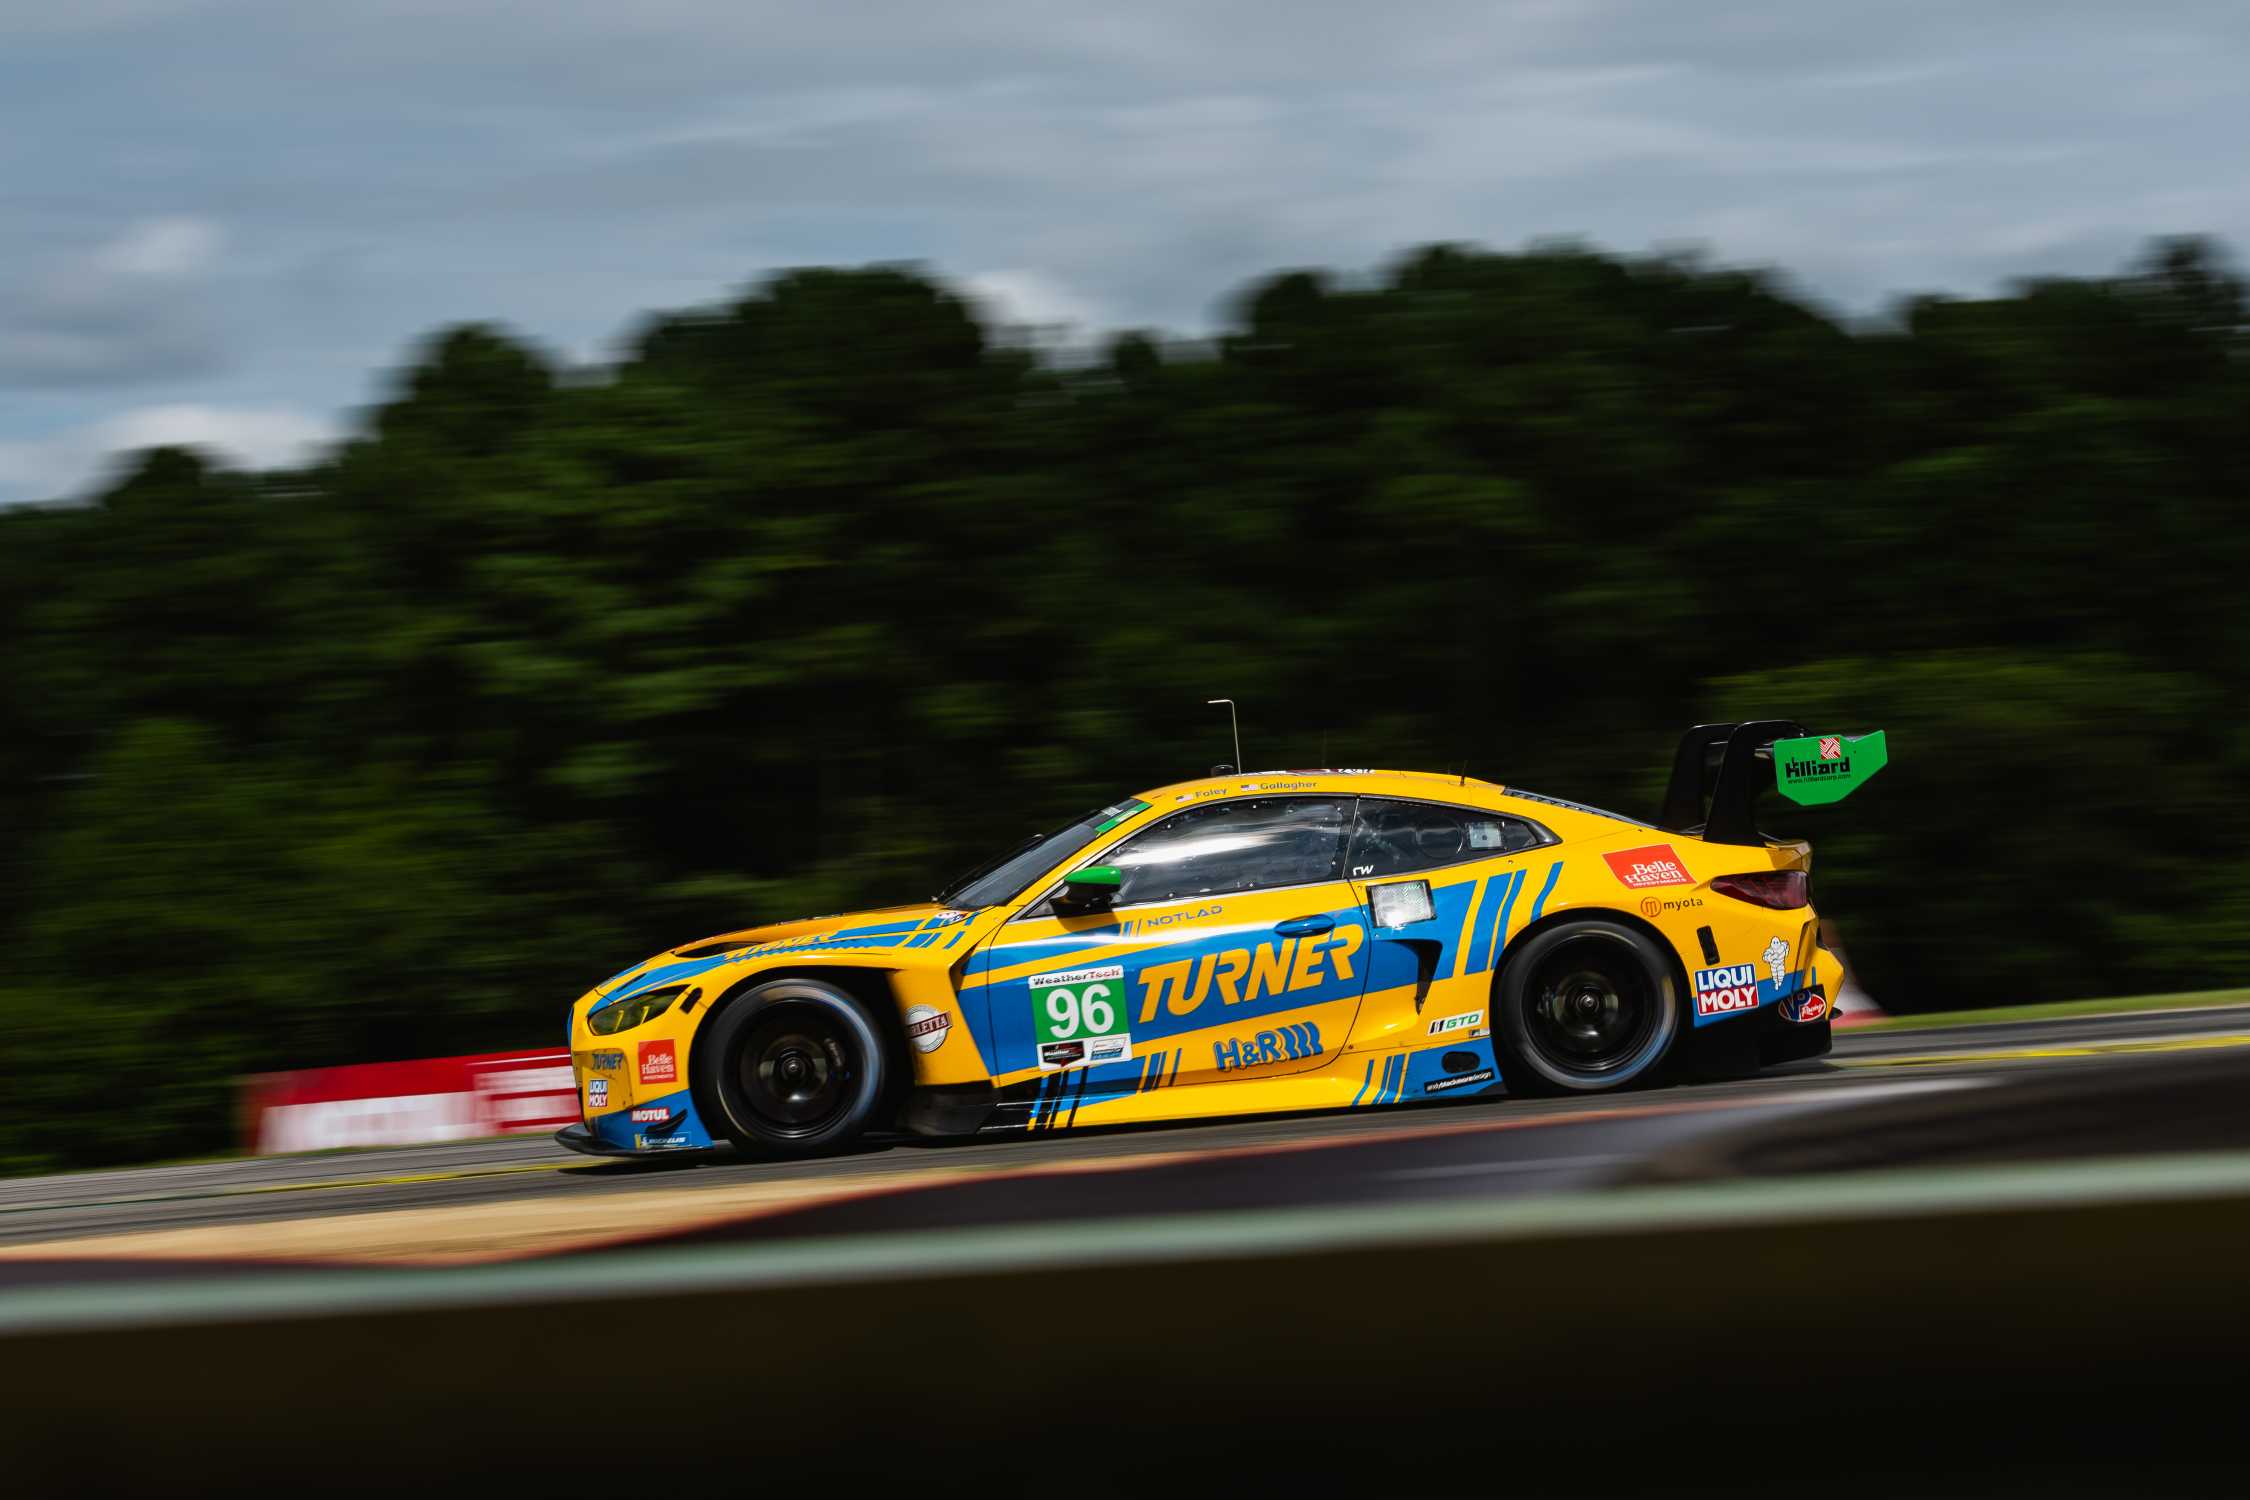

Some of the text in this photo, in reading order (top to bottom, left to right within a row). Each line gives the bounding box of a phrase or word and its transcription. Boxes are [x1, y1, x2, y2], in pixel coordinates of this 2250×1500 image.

[1785, 757, 1851, 779] Hilliard
[1195, 787, 1228, 798] Foley
[1260, 780, 1318, 791] Gallagher
[1632, 860, 1678, 876] Belle
[1624, 870, 1683, 884] Haven
[1663, 897, 1704, 912] myota
[1147, 904, 1223, 928] NOTLAD
[1032, 967, 1121, 987] WeatherTech
[1138, 924, 1364, 1025] TURNER
[1697, 965, 1754, 991] LIQUI
[1699, 986, 1757, 1014] MOLY
[1046, 983, 1115, 1039] 96
[1446, 1013, 1480, 1030] GTD
[648, 1053, 674, 1066] Belle
[1213, 1030, 1288, 1074] H&R
[641, 1063, 675, 1075] Haven
[589, 1093, 608, 1106] MOLY
[631, 1108, 670, 1120] MOTUL
